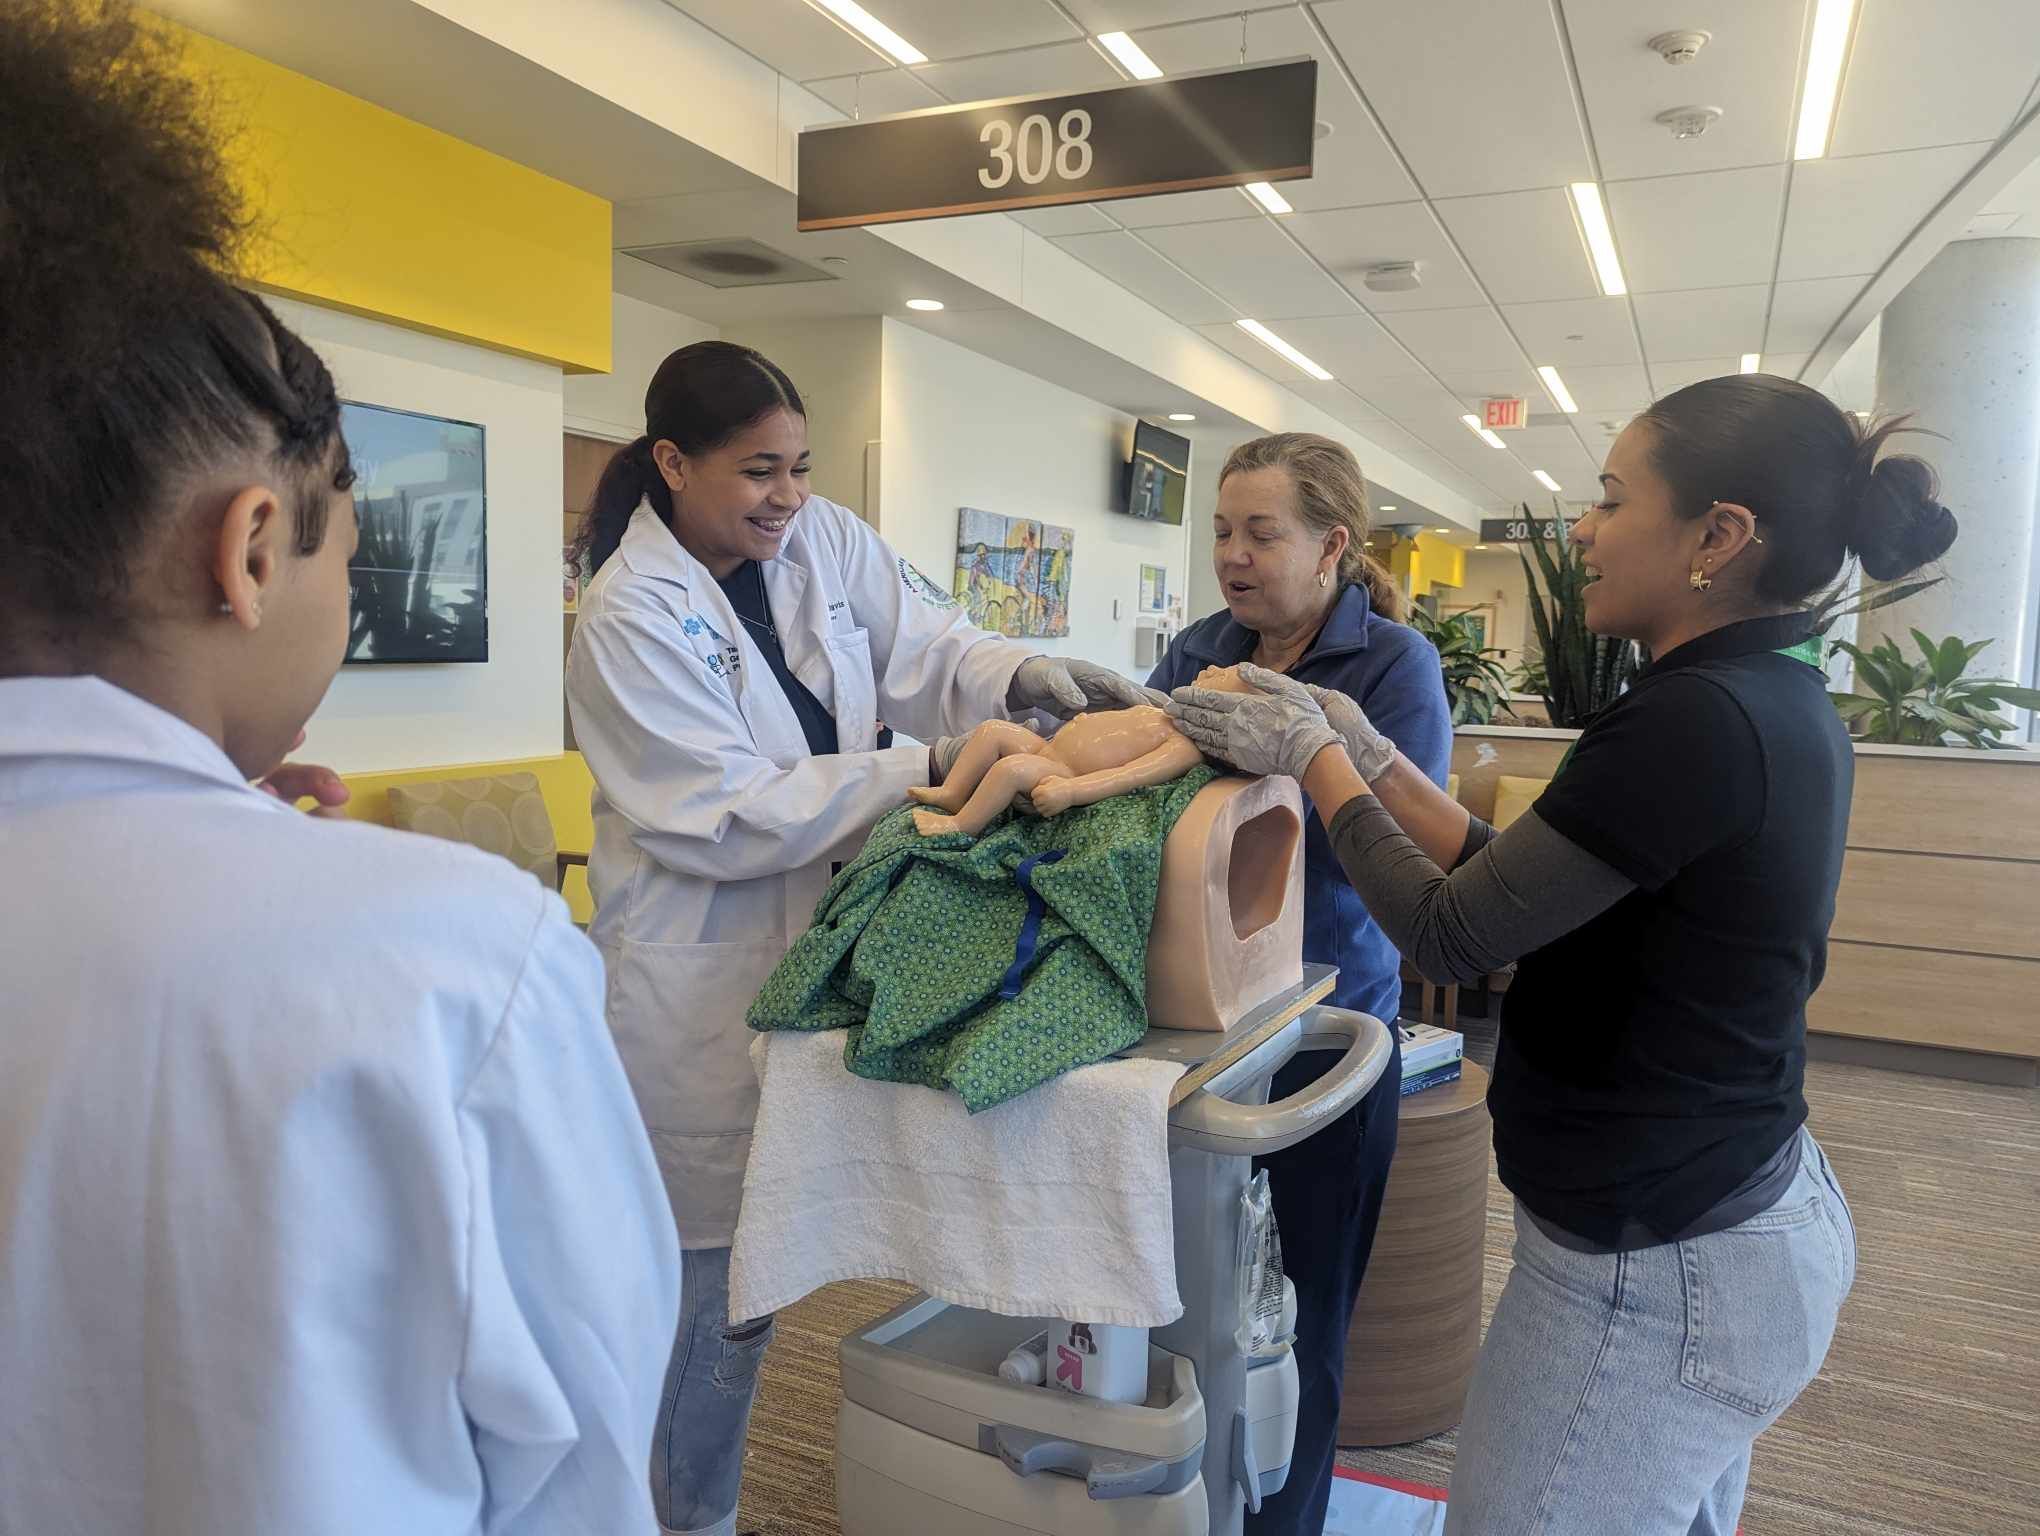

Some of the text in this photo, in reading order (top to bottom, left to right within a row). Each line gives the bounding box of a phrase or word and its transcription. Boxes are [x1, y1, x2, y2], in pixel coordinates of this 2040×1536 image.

[978, 108, 1094, 189] 308
[1487, 400, 1520, 427] EXIT
[1505, 521, 1540, 540] 30
